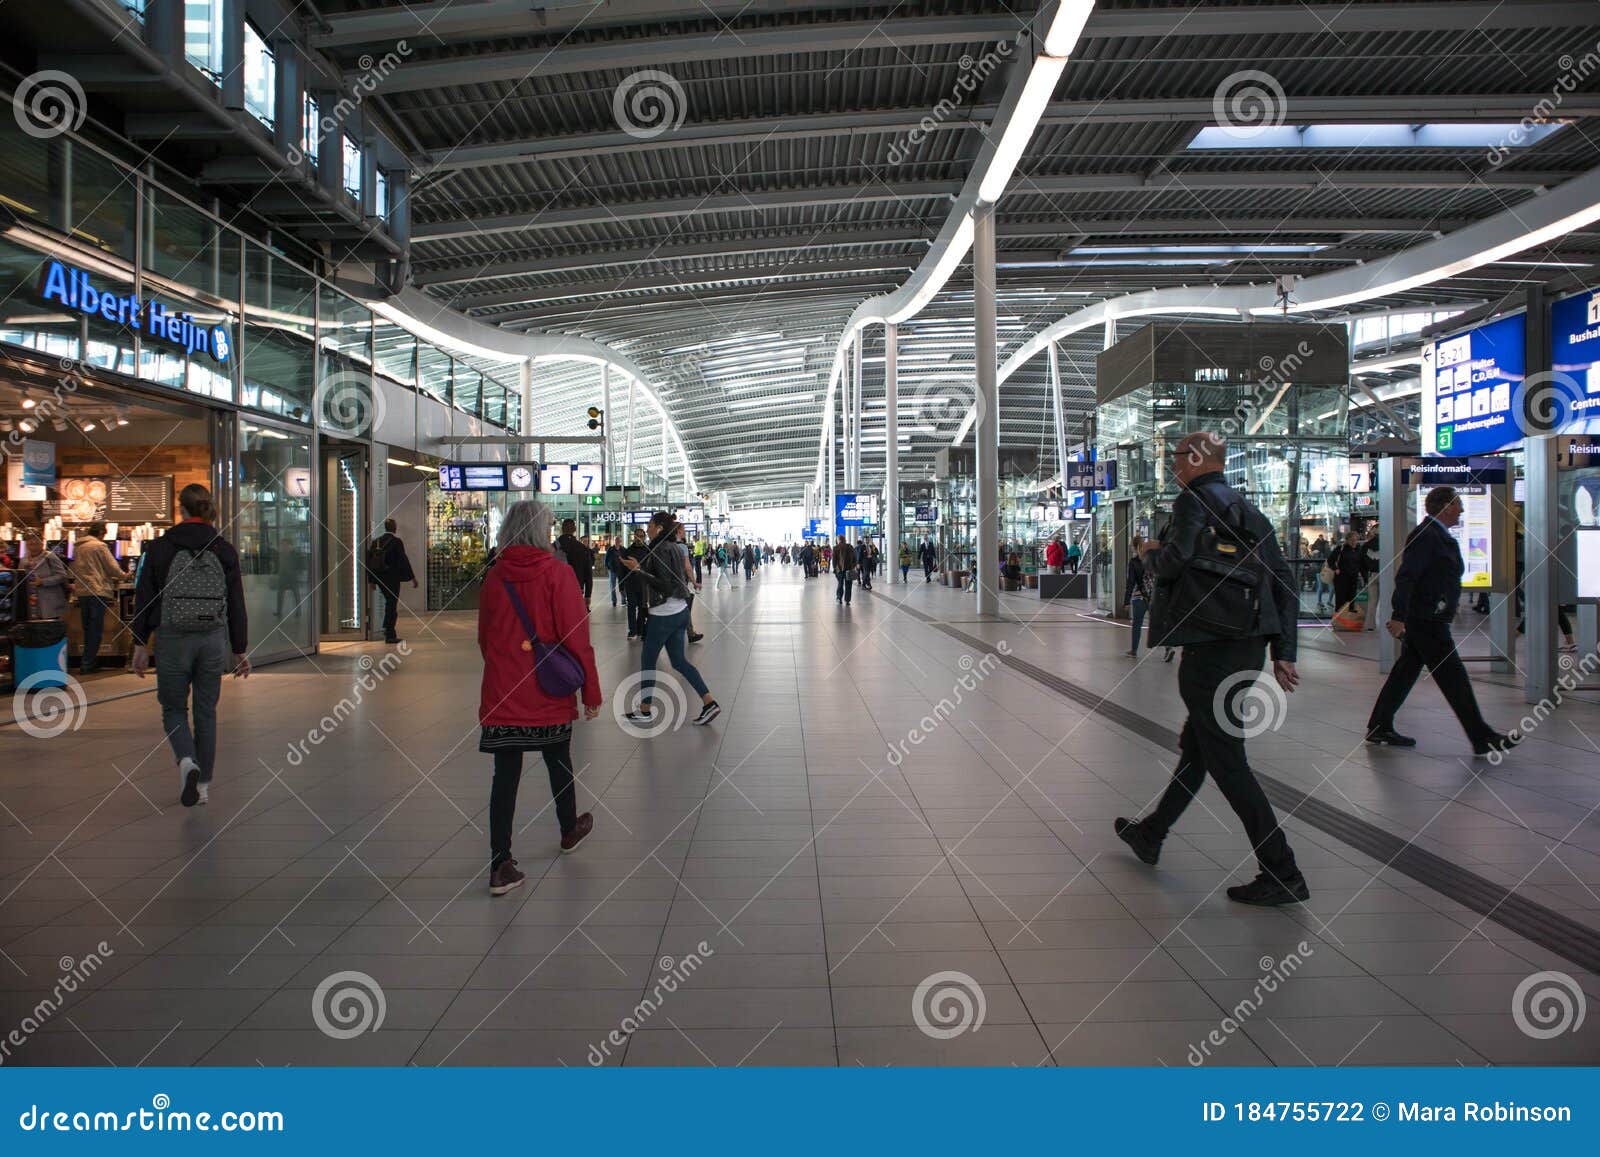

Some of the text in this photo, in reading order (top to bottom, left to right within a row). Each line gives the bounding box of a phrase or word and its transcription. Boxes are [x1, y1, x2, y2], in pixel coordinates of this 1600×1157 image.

[43, 261, 208, 355] Albert Heijn
[214, 329, 225, 343] to
[217, 342, 228, 359] go
[1078, 464, 1093, 472] Lift
[1410, 464, 1471, 473] Reisinformatie
[550, 476, 561, 491] 5
[582, 476, 594, 491] 7
[1351, 473, 1361, 490] 7
